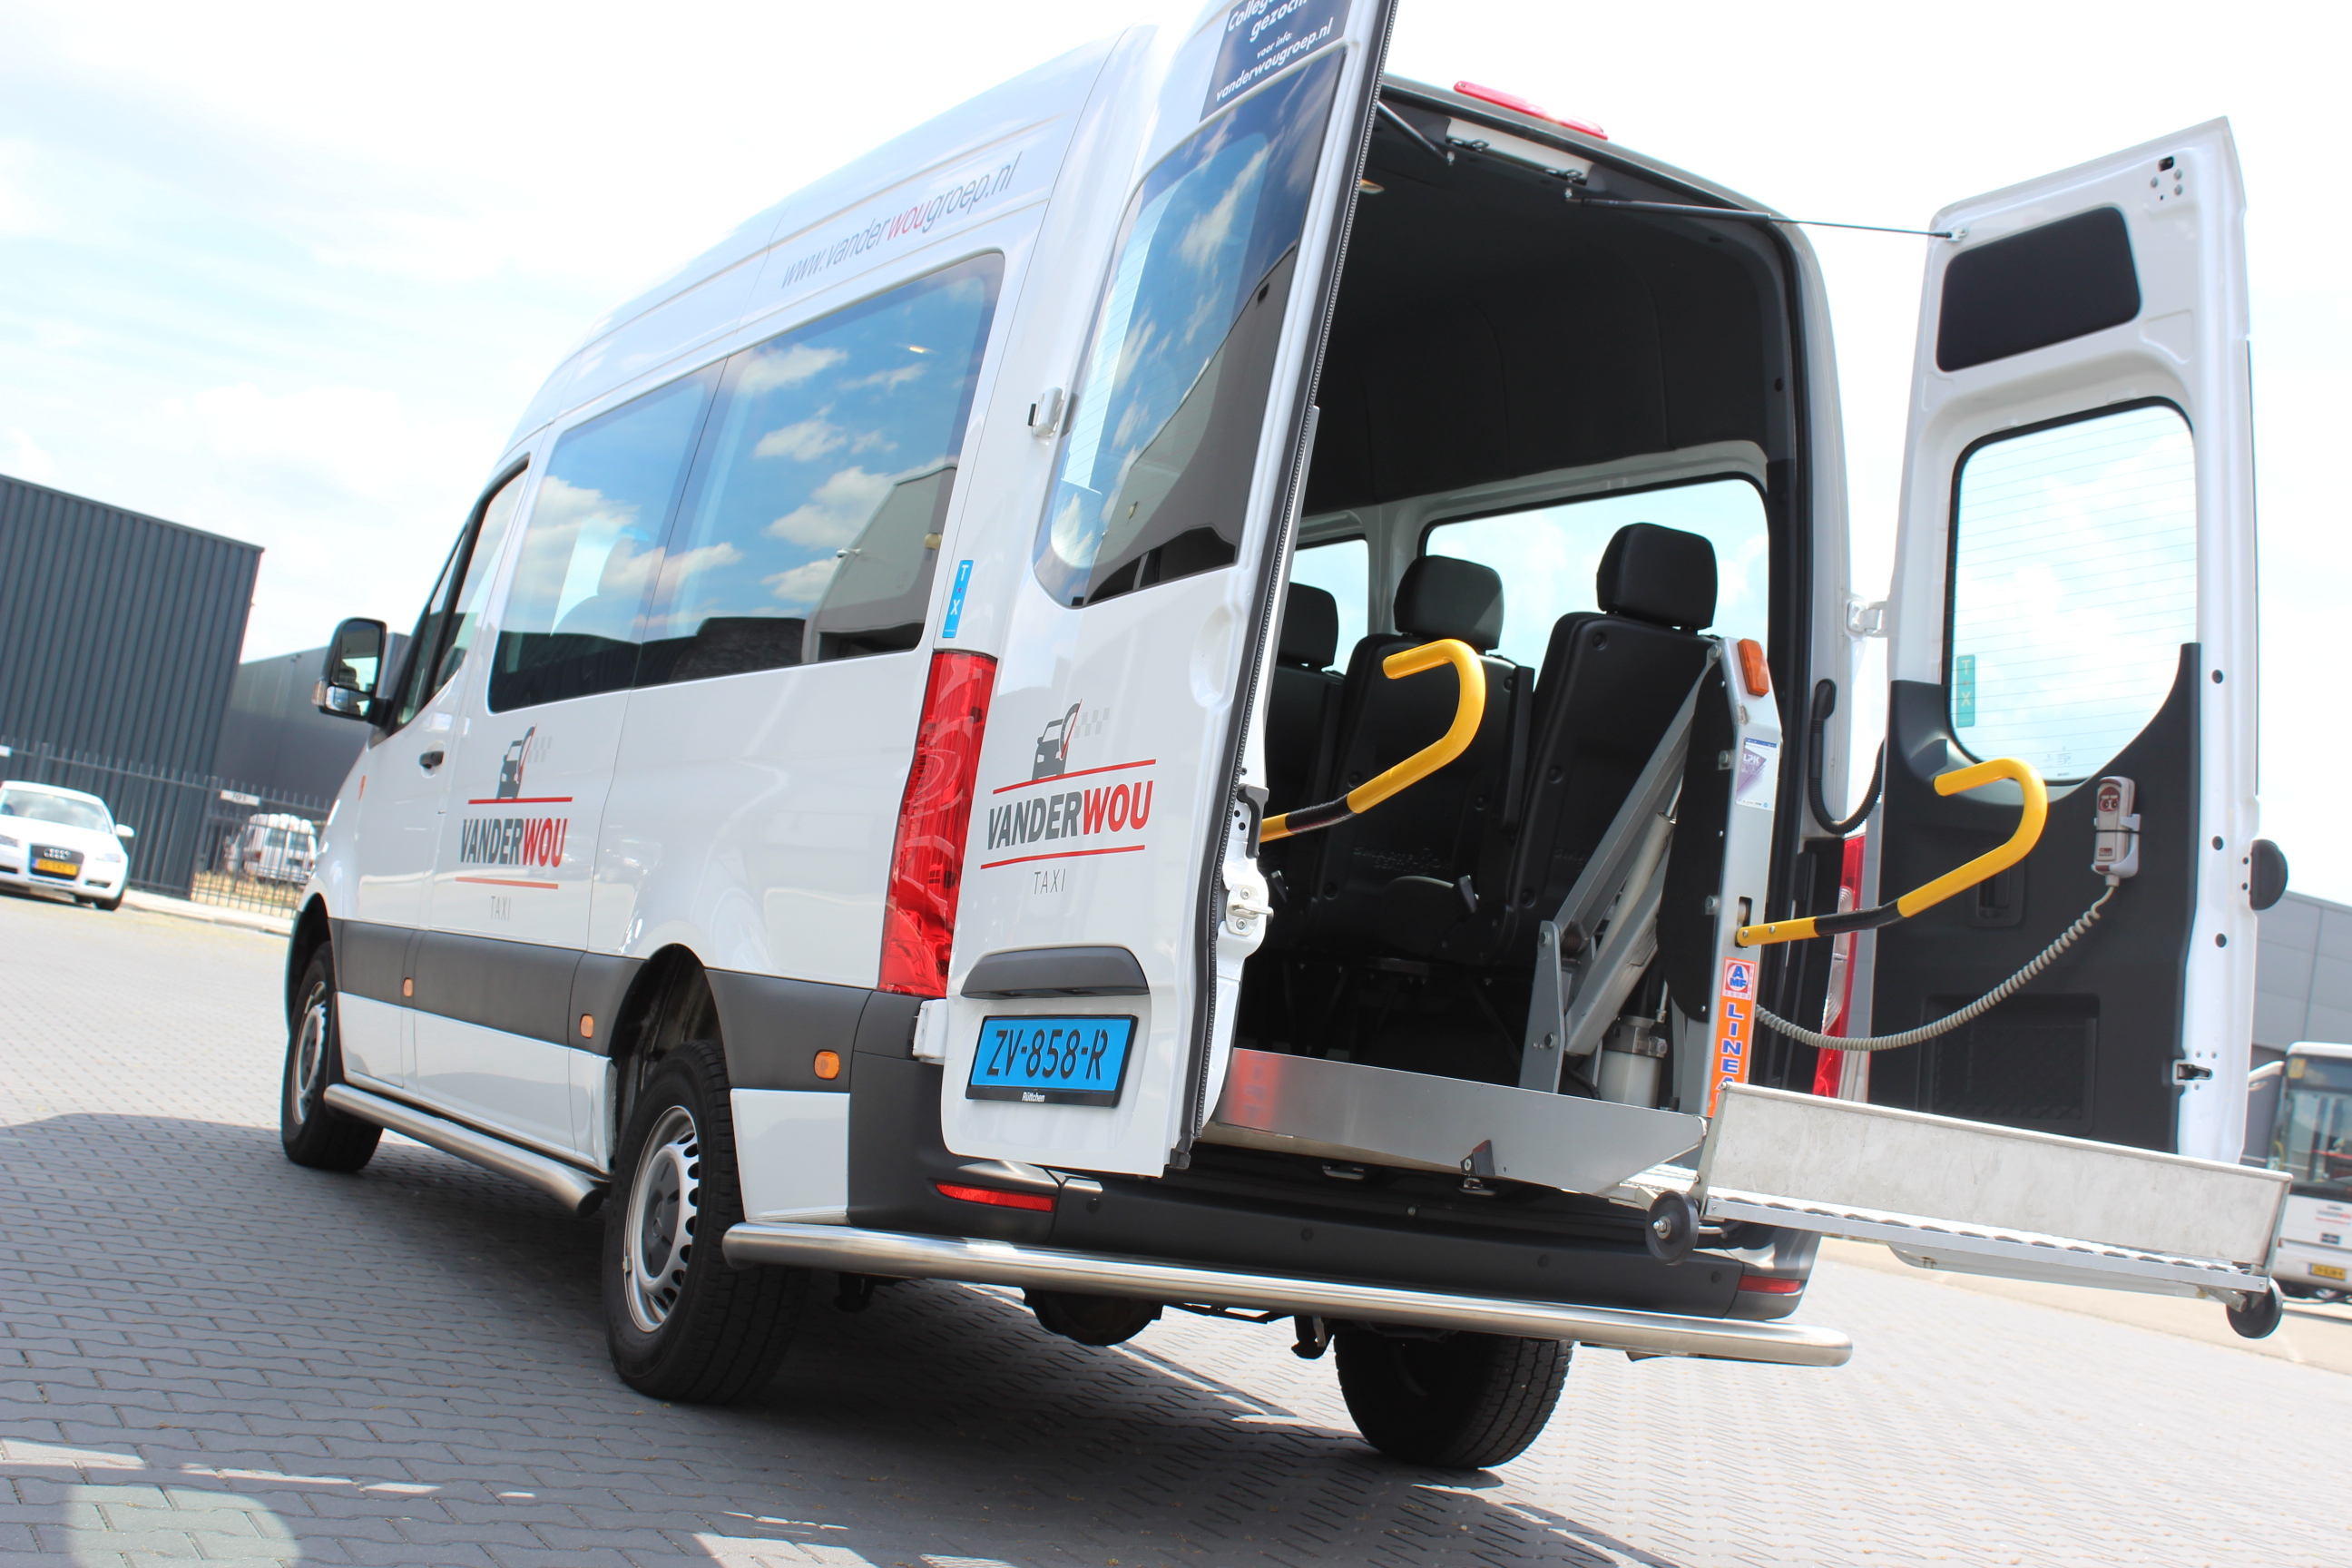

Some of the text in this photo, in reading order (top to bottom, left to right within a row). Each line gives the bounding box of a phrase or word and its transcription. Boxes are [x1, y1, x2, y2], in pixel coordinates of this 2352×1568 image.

[1228, 0, 1274, 32] Colleg
[1250, 0, 1308, 43] gezoc
[1216, 16, 1333, 102] vanderwougroep.nl
[1257, 31, 1293, 59] voor info:
[781, 151, 1023, 289] www.vanderwougroep.nl
[987, 780, 1153, 850] VANDERWOU
[460, 818, 568, 867] VANDERWOU
[1033, 868, 1066, 895] TAXI
[490, 896, 512, 921] TAXI
[986, 1029, 1109, 1080] ZV-858-R
[1717, 1002, 1744, 1090] LINE
